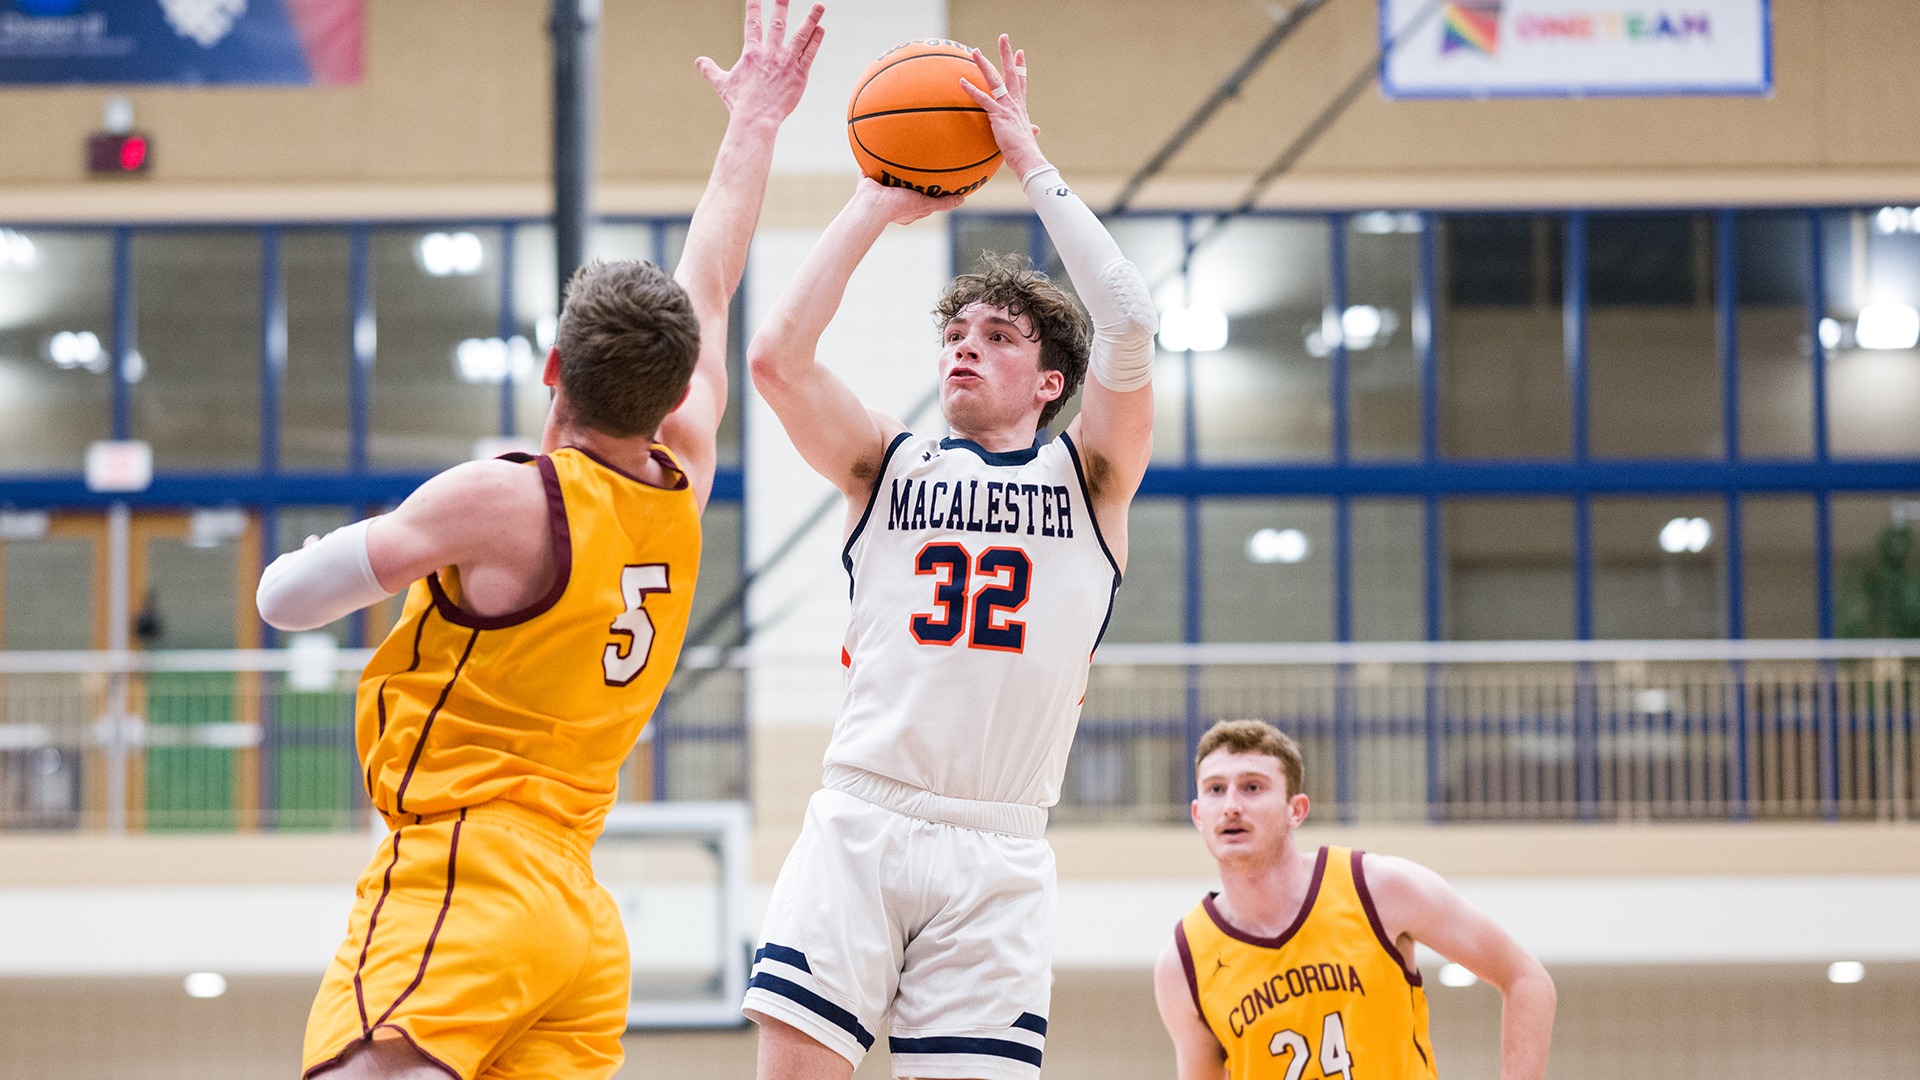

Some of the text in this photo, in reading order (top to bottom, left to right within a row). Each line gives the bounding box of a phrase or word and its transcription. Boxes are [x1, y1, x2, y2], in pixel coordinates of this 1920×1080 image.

[888, 479, 1074, 538] MACALESTER
[602, 563, 671, 687] 5
[909, 542, 1033, 654] 32
[1229, 963, 1366, 1038] CONCORDIA
[1268, 1011, 1354, 1080] 24
